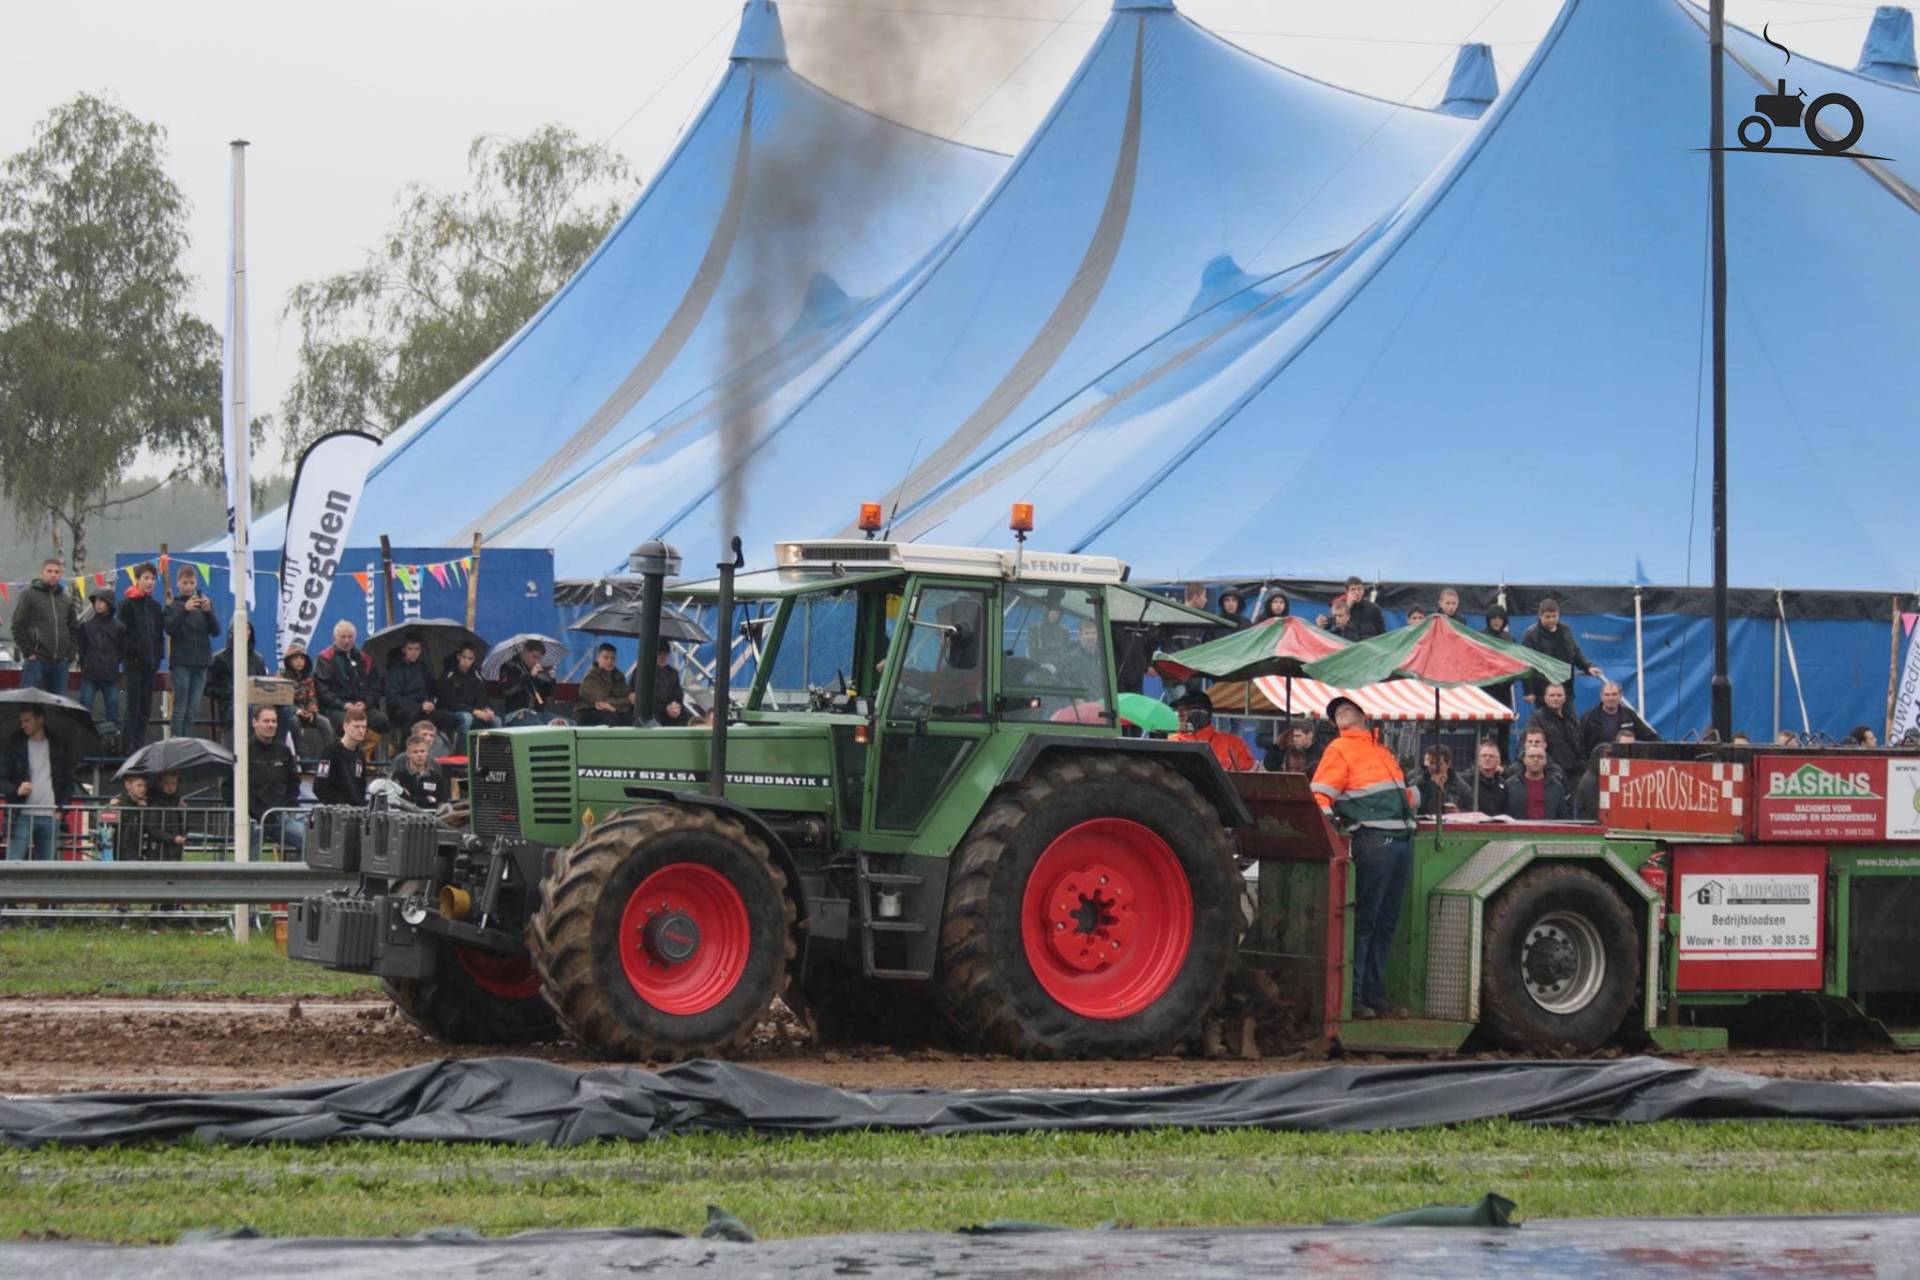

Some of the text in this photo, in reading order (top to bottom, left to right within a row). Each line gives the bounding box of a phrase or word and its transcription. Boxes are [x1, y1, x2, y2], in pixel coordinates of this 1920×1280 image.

[1030, 560, 1081, 573] FENDT
[578, 768, 697, 782] FAVORIT 612 LSA
[725, 774, 829, 787] TURBOMATIK E
[1622, 766, 1719, 812] HYPROSLEE
[1770, 772, 1870, 795] BASRIJS
[1795, 804, 1852, 812] MACHINES VOOR
[1686, 935, 1714, 946] Wouw
[1724, 935, 1738, 946] tel:
[1741, 935, 1763, 946] 0165
[1772, 935, 1783, 946] 30
[1785, 935, 1796, 946] 35
[1799, 935, 1810, 946] 25
